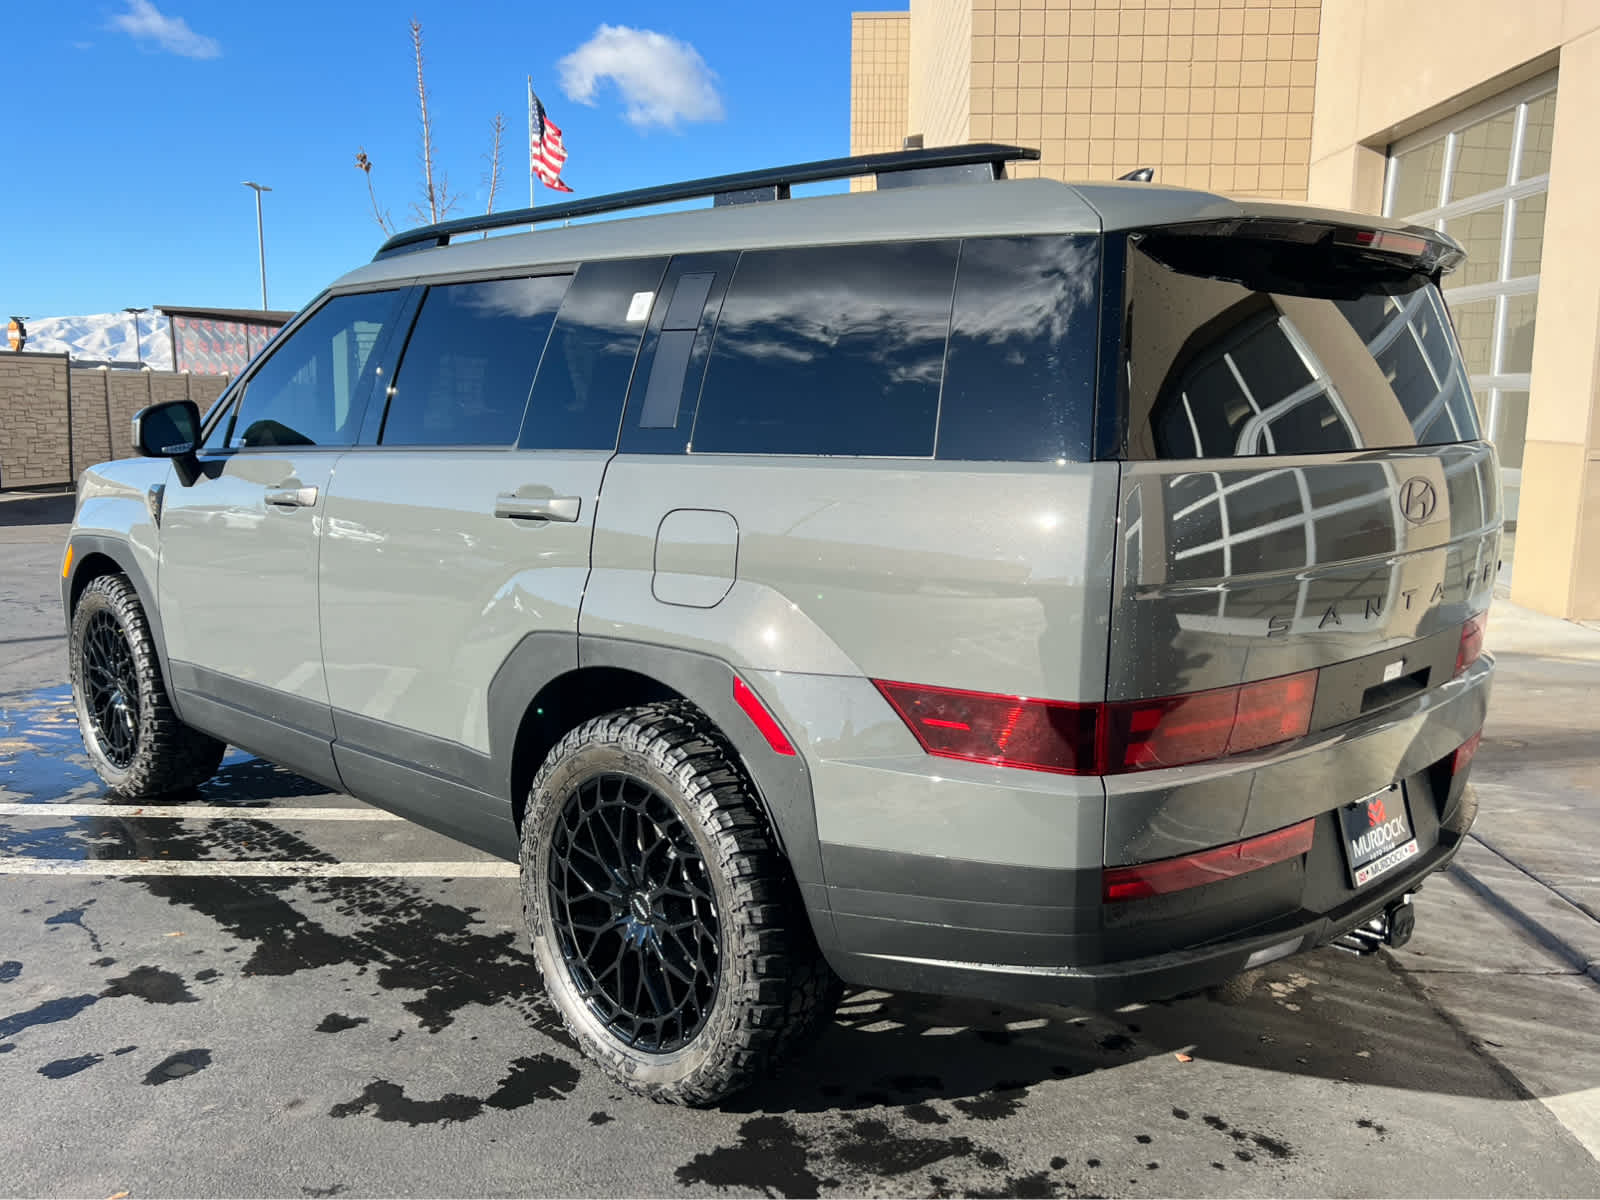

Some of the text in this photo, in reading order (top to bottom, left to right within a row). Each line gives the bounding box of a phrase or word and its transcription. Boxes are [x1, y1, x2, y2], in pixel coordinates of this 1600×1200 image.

[1267, 582, 1445, 638] SANTA
[1352, 815, 1406, 858] MURDOCK
[1371, 848, 1405, 874] MURDOCK
